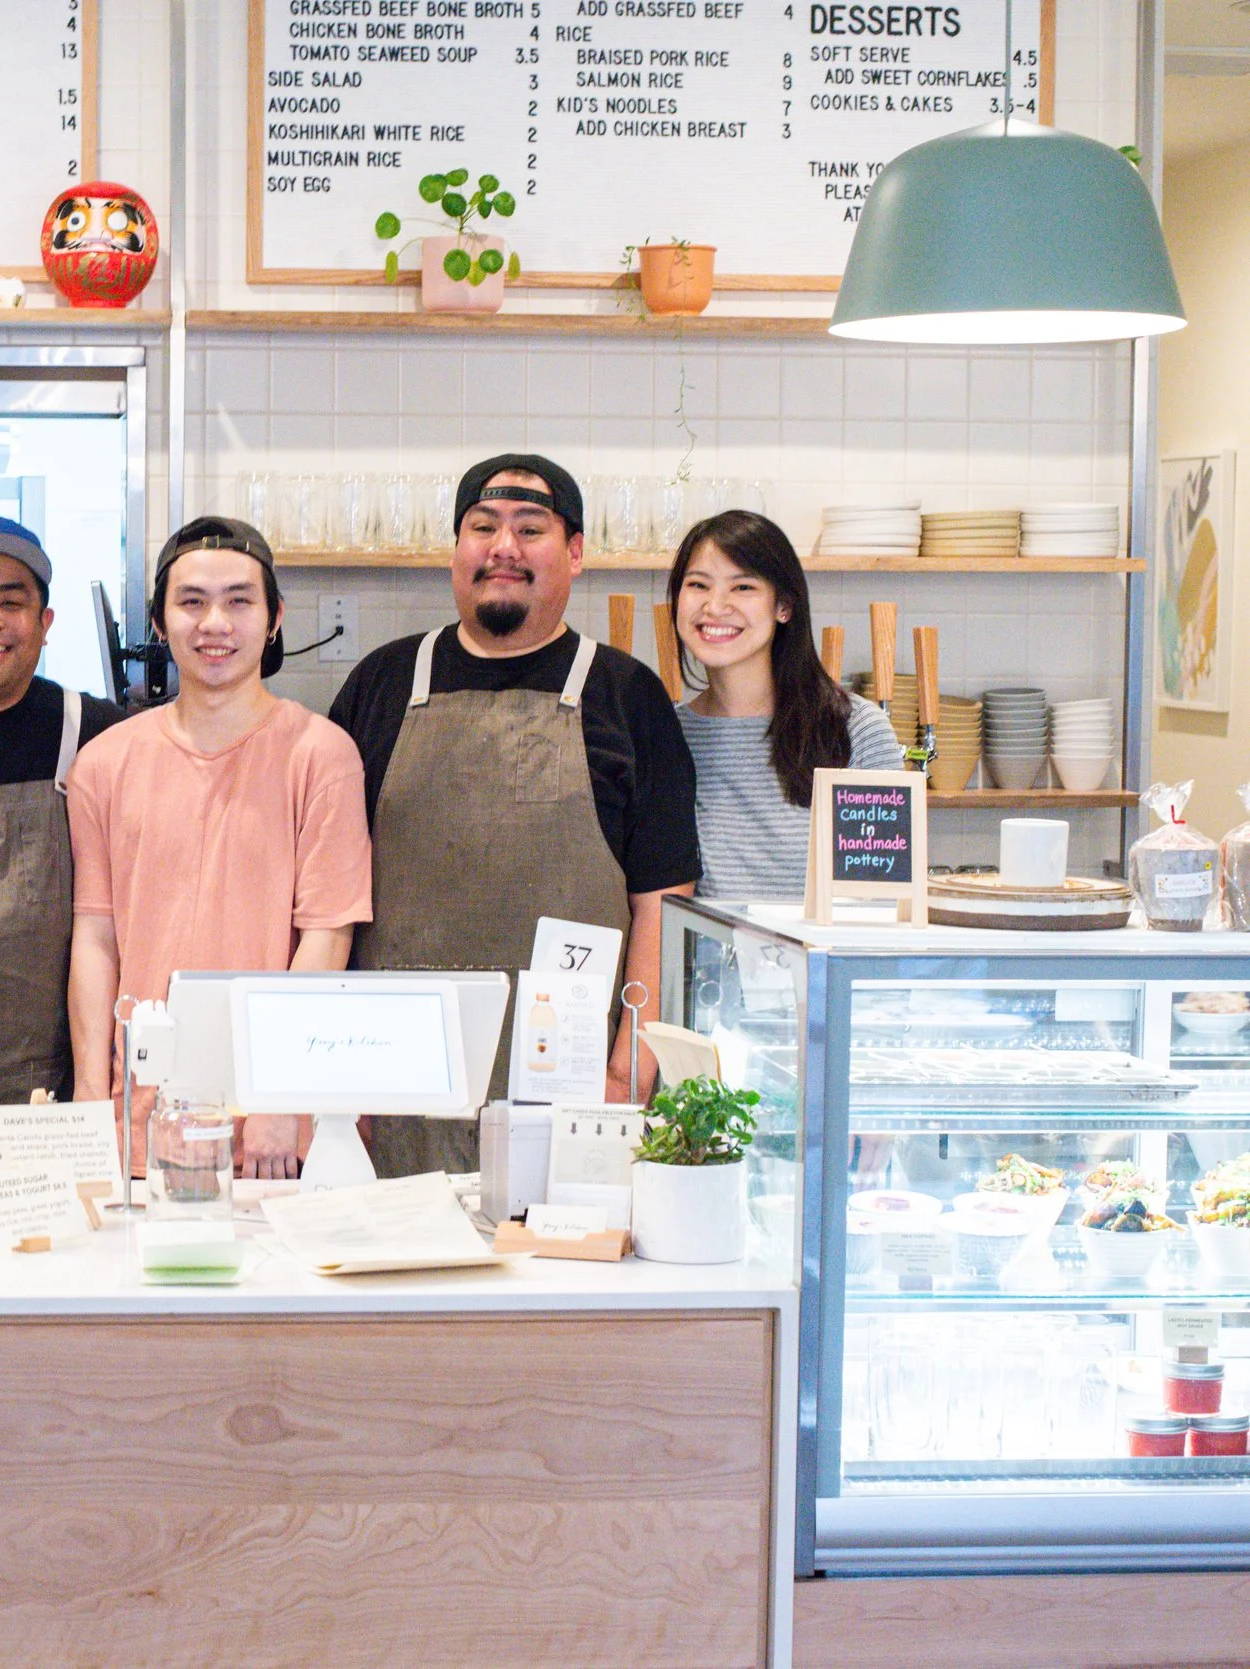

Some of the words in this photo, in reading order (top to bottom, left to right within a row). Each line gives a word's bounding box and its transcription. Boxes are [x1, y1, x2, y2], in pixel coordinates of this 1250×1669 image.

[289, 0, 373, 17] GRASSFED
[378, 0, 420, 18] BEEF
[426, 0, 468, 18] BONE
[474, 1, 524, 19] BROTH
[576, 0, 609, 17] ADD
[614, 0, 697, 19] GRASSFED
[704, 1, 744, 19] BEEF
[810, 3, 962, 38] DESSERTS
[289, 21, 358, 39] CHICKEN
[365, 22, 407, 40] BONE
[413, 23, 465, 41] BROTH
[555, 25, 593, 43] RICE
[289, 44, 351, 62] TOMATO
[357, 45, 431, 63] SEAWEED
[437, 46, 478, 64] SOUP
[514, 47, 540, 65] 3.5
[576, 48, 644, 66] BRAISED
[649, 49, 689, 67] PORK
[694, 50, 730, 68] RICE
[810, 45, 853, 62] SOFT
[859, 46, 911, 64] SERVE
[1012, 49, 1038, 67] 4.5
[267, 70, 304, 88] SIDE
[310, 70, 363, 89] SALAD
[576, 70, 641, 89] SALMON
[648, 71, 684, 89] RICE
[824, 67, 855, 85] ADD
[861, 68, 913, 86] SWEET
[1023, 71, 1038, 89] .5
[57, 88, 78, 105] 1.5
[267, 96, 341, 114] AVOCADO
[556, 96, 599, 114] KID'S
[605, 97, 678, 115] NOODLES
[810, 93, 880, 112] COOKIES
[900, 95, 954, 113] CAKES
[268, 123, 366, 141] KOSHIHIKARI
[373, 124, 423, 142] WHITE
[429, 125, 466, 142] RICE
[575, 119, 608, 137] ADD
[613, 119, 681, 138] CHICKEN
[687, 121, 748, 139] BREAST
[267, 149, 360, 168] MULTIGRAIN
[366, 150, 402, 169] RICE
[808, 160, 860, 178] THANK
[266, 175, 297, 193] SOY
[302, 175, 331, 193] EGG
[837, 788, 906, 806] Homemade
[860, 822, 875, 837] in
[838, 834, 908, 851] handmade
[845, 854, 895, 873] pottery
[558, 943, 592, 972] 37
[35, 1115, 70, 1125] SPECIAL
